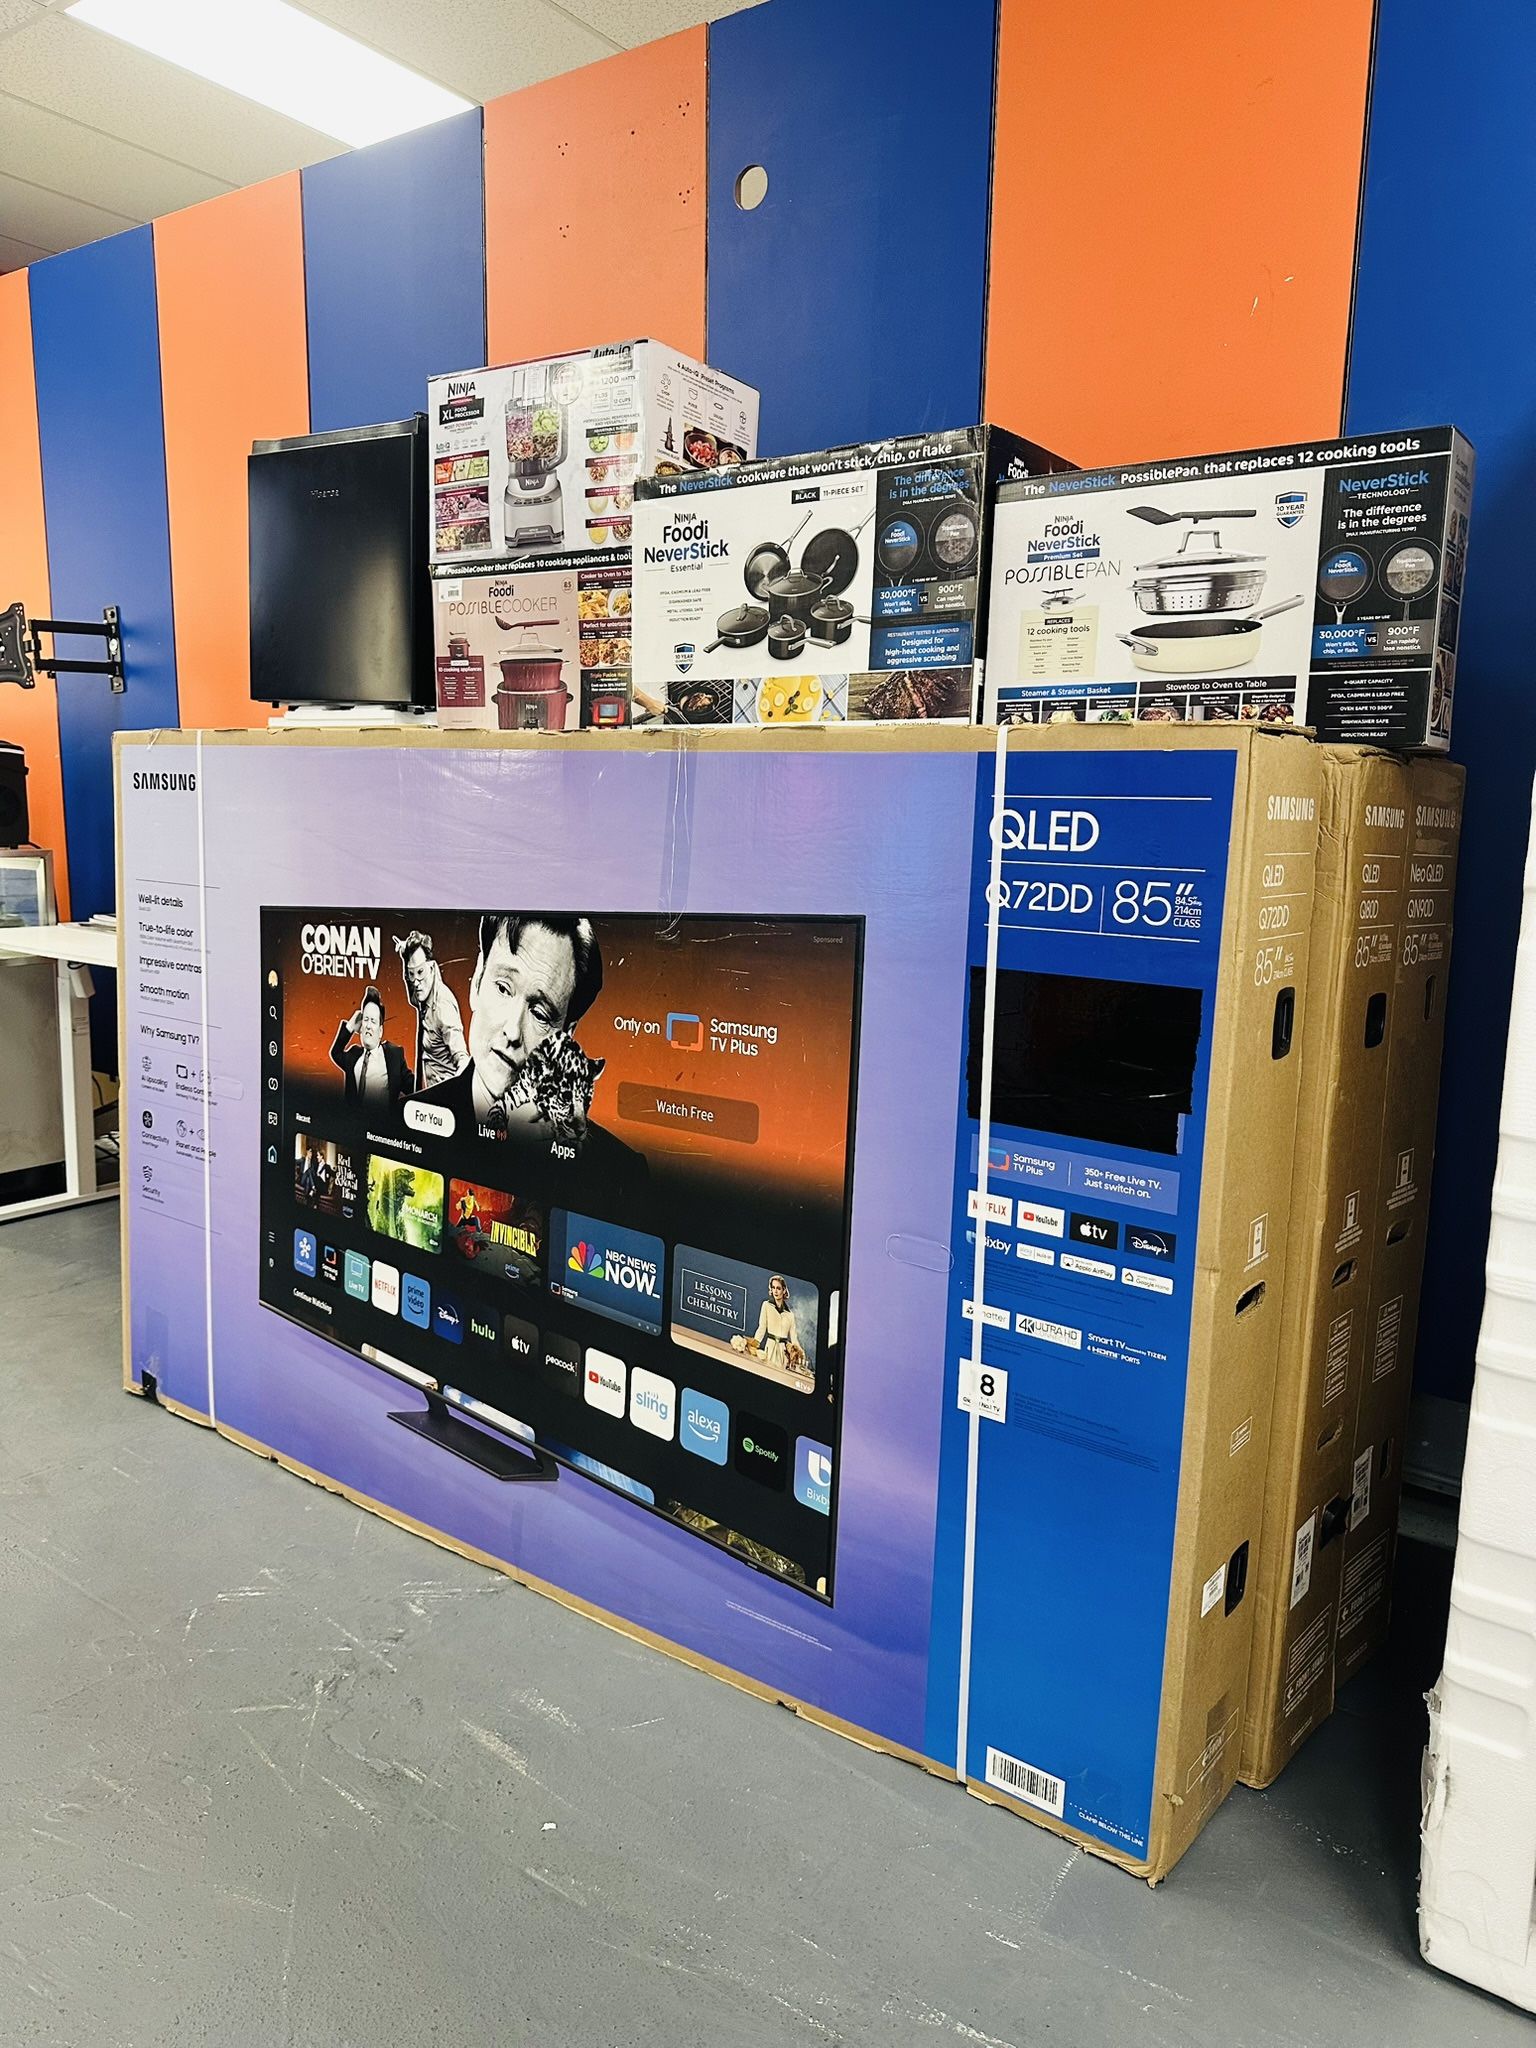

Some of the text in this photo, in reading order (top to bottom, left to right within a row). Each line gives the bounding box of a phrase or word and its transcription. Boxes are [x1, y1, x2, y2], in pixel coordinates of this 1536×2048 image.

[448, 382, 476, 398] NINJA
[442, 409, 454, 421] XL
[454, 409, 480, 418] PROCESSOR
[659, 484, 677, 495] The
[680, 475, 733, 492] NeverStick
[736, 467, 786, 485] cookware
[788, 465, 811, 477] that
[812, 459, 842, 473] won't
[877, 451, 905, 464] chip,
[908, 450, 921, 459] or
[922, 444, 952, 457] flake
[1024, 438, 1421, 496] The NeverStick PossiblePan that replaces 12 cooking tools
[1339, 470, 1430, 493] NeverStick
[795, 485, 864, 500] BLACK 11-PIECE SET
[1357, 488, 1411, 499] TECHNOLOGY
[674, 513, 697, 524] NINJA
[1343, 503, 1422, 518] The difference
[1044, 520, 1084, 538] Foodi
[1337, 513, 1427, 530] is in the degrees
[663, 520, 709, 543] Foodi
[644, 539, 730, 563] NeverStick
[1028, 534, 1101, 552] NeverStick
[447, 564, 494, 575] PossibleCooker
[495, 563, 508, 571] that
[508, 560, 535, 570] replaces
[536, 559, 544, 567] 10
[544, 556, 572, 568] cooking
[572, 553, 610, 566] appliances
[616, 551, 632, 560] tool
[1043, 553, 1072, 561] Premium
[670, 562, 703, 573] Essential
[488, 585, 515, 598] Foodi
[1319, 629, 1365, 640] 30,000°F
[1387, 626, 1420, 636] 900°F
[885, 648, 917, 656] high-heat
[918, 645, 945, 654] cooking
[901, 638, 933, 647] Designed
[886, 654, 957, 665] aggressive scrubbing
[1087, 686, 1111, 694] Basket
[1165, 683, 1200, 691] Stovetop
[1201, 682, 1210, 690] to
[1212, 681, 1233, 689] Oven
[1245, 680, 1268, 688] Table
[133, 772, 196, 791] SAMSUNG
[1267, 795, 1315, 822] SAMSUNG
[1365, 804, 1405, 830] SAMSUNG
[1416, 804, 1456, 829] SAMSUNG
[989, 809, 1100, 852] QLED
[1262, 864, 1285, 887] QLED
[1362, 863, 1380, 884] QLED
[1410, 863, 1444, 884] Neo QLED
[138, 893, 184, 908] Well-lit details
[985, 879, 1195, 927] Q72DD 85"
[1360, 899, 1379, 919] Q80D
[1407, 898, 1435, 919] QN90D
[1174, 905, 1202, 916] 214cm
[1258, 904, 1290, 931] Q72DD
[139, 921, 194, 938] True-to-life color
[1173, 917, 1201, 929] CLASS
[301, 923, 381, 958] CONAN
[1402, 933, 1428, 966] 85"
[1355, 934, 1378, 968] 85"
[139, 956, 175, 970] Impressive
[176, 961, 202, 974] contras
[1254, 945, 1284, 986] 85"
[140, 983, 165, 996] Smooth
[166, 989, 190, 1000] motion
[140, 1024, 200, 1046] Why Samsung TV?
[614, 1016, 660, 1036] Only on
[710, 1018, 778, 1045] Samsung
[710, 1036, 758, 1057] TV Plus
[415, 1109, 443, 1127] For You
[656, 1099, 714, 1122] Watch Free
[141, 1131, 170, 1145] Connectivity
[478, 1123, 496, 1141] Live
[550, 1141, 576, 1160] Apps
[1013, 1153, 1056, 1171] Samsung
[1013, 1162, 1044, 1177] TV Plus
[1083, 1177, 1151, 1199] Just switch on.
[1084, 1167, 1162, 1191] 350+ Free Live TV.
[142, 1185, 161, 1197] Security
[408, 1208, 438, 1223] MONARCH
[1035, 1214, 1059, 1227] YouTube
[490, 1220, 537, 1257] INVINCIBLE
[984, 1235, 1012, 1256] ixby
[605, 1249, 657, 1274] NBC NEWS
[1075, 1262, 1113, 1279] Apple AirPlay
[374, 1278, 396, 1296] NETFLIX
[694, 1280, 733, 1301] LESSONS
[293, 1287, 332, 1315] Continue Watching
[687, 1295, 739, 1320] CHEMISTRY
[471, 1318, 496, 1341] hulu
[545, 1354, 575, 1373] peacock
[1120, 1354, 1141, 1365] PORTS
[600, 1375, 622, 1394] YouTube
[636, 1391, 668, 1421] sling
[688, 1408, 721, 1436] alexa
[754, 1444, 779, 1463] Spotify
[1078, 1811, 1144, 1847] CLAMP BELOW THIS LINE
